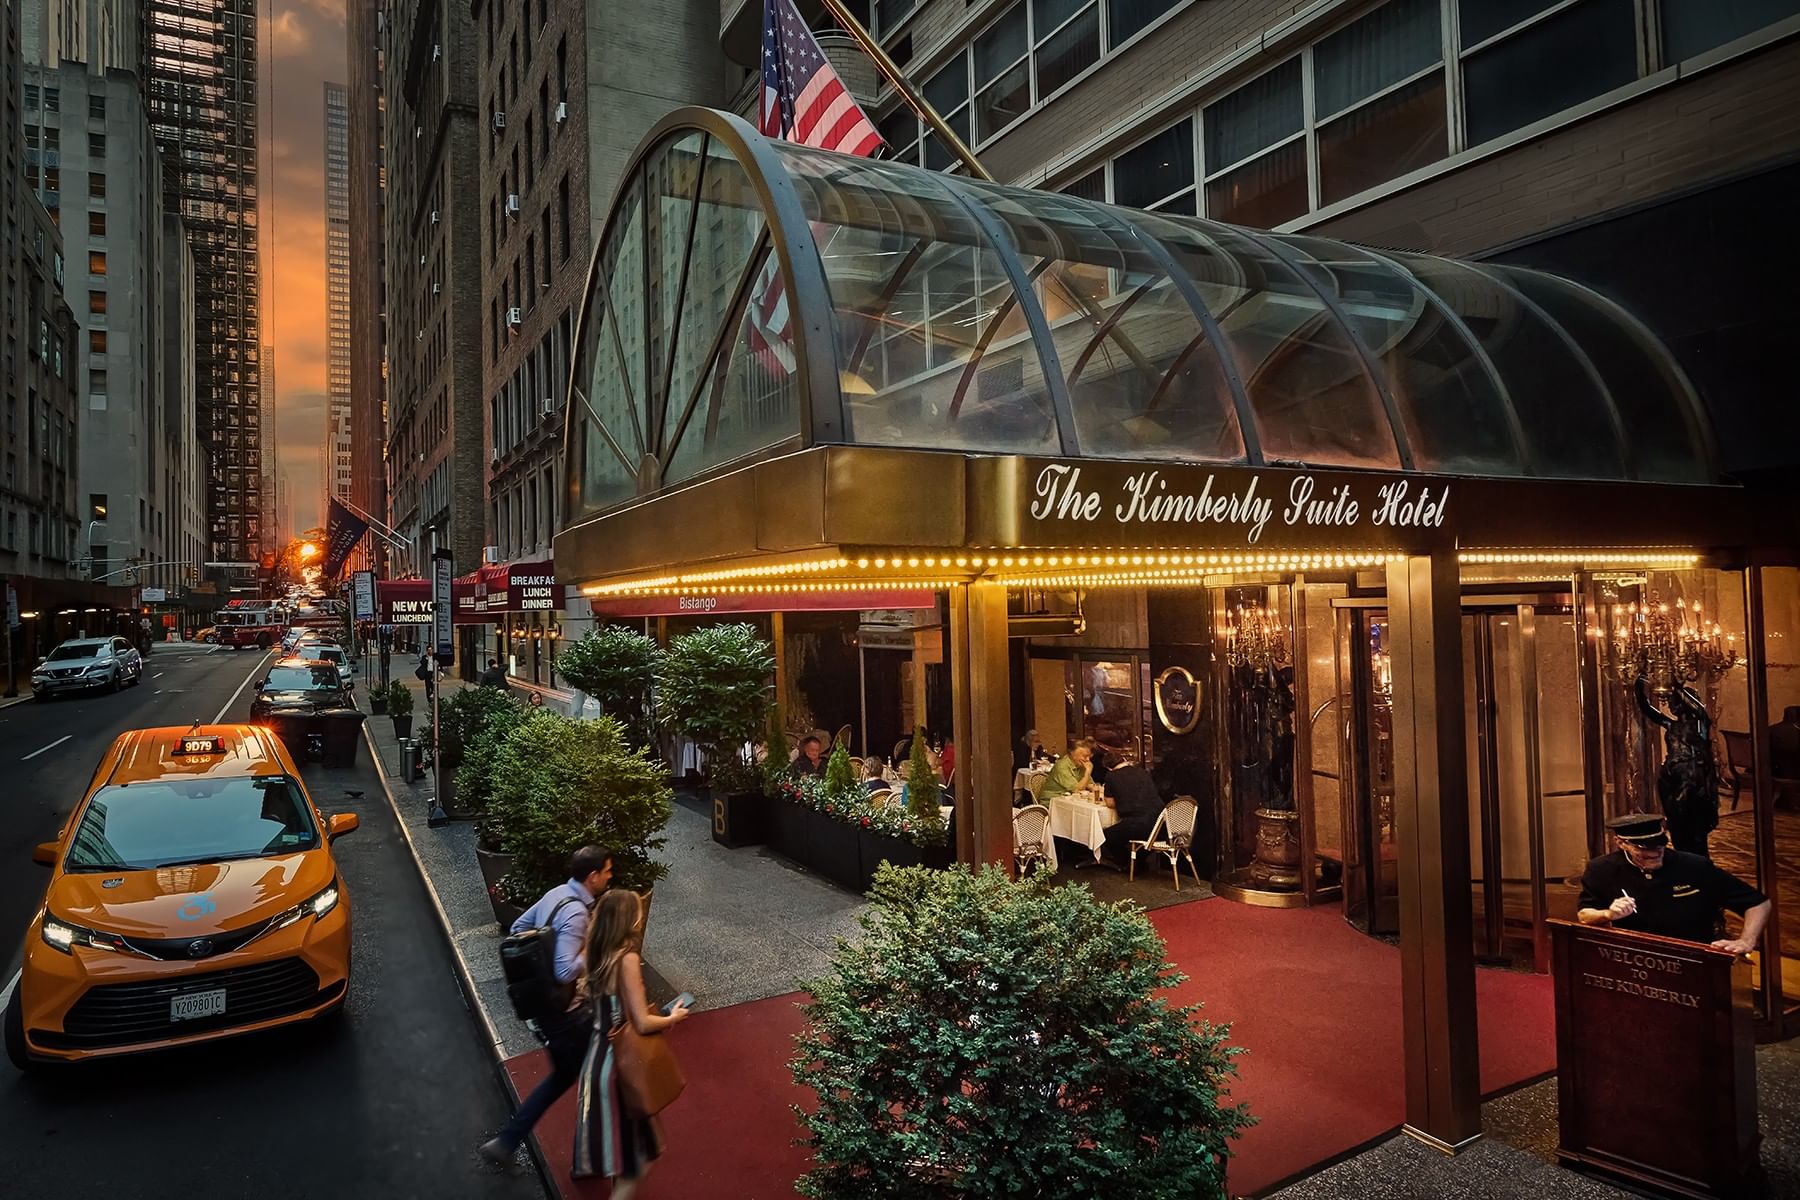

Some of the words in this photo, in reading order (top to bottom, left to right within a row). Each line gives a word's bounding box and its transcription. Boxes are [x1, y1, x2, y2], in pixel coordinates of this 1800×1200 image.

[1030, 463, 1102, 521] The
[1115, 471, 1272, 545] Kimberly
[1283, 475, 1359, 526] Suite
[1372, 480, 1450, 528] Hotel
[510, 576, 555, 585] BREAKFAS
[523, 587, 552, 597] LUNCH
[392, 601, 418, 612] NEW
[419, 601, 433, 612] YO
[522, 599, 554, 609] DINNER
[680, 596, 717, 611] Bistango
[392, 614, 433, 623] LUNCHEON
[185, 741, 212, 752] 9D79
[714, 799, 725, 835] B
[1598, 947, 1682, 974] WELCOME
[1631, 968, 1649, 981] TO
[1584, 973, 1615, 990] THE
[1616, 980, 1701, 1008] KIMBERLY
[175, 996, 221, 1015] Y209801C
